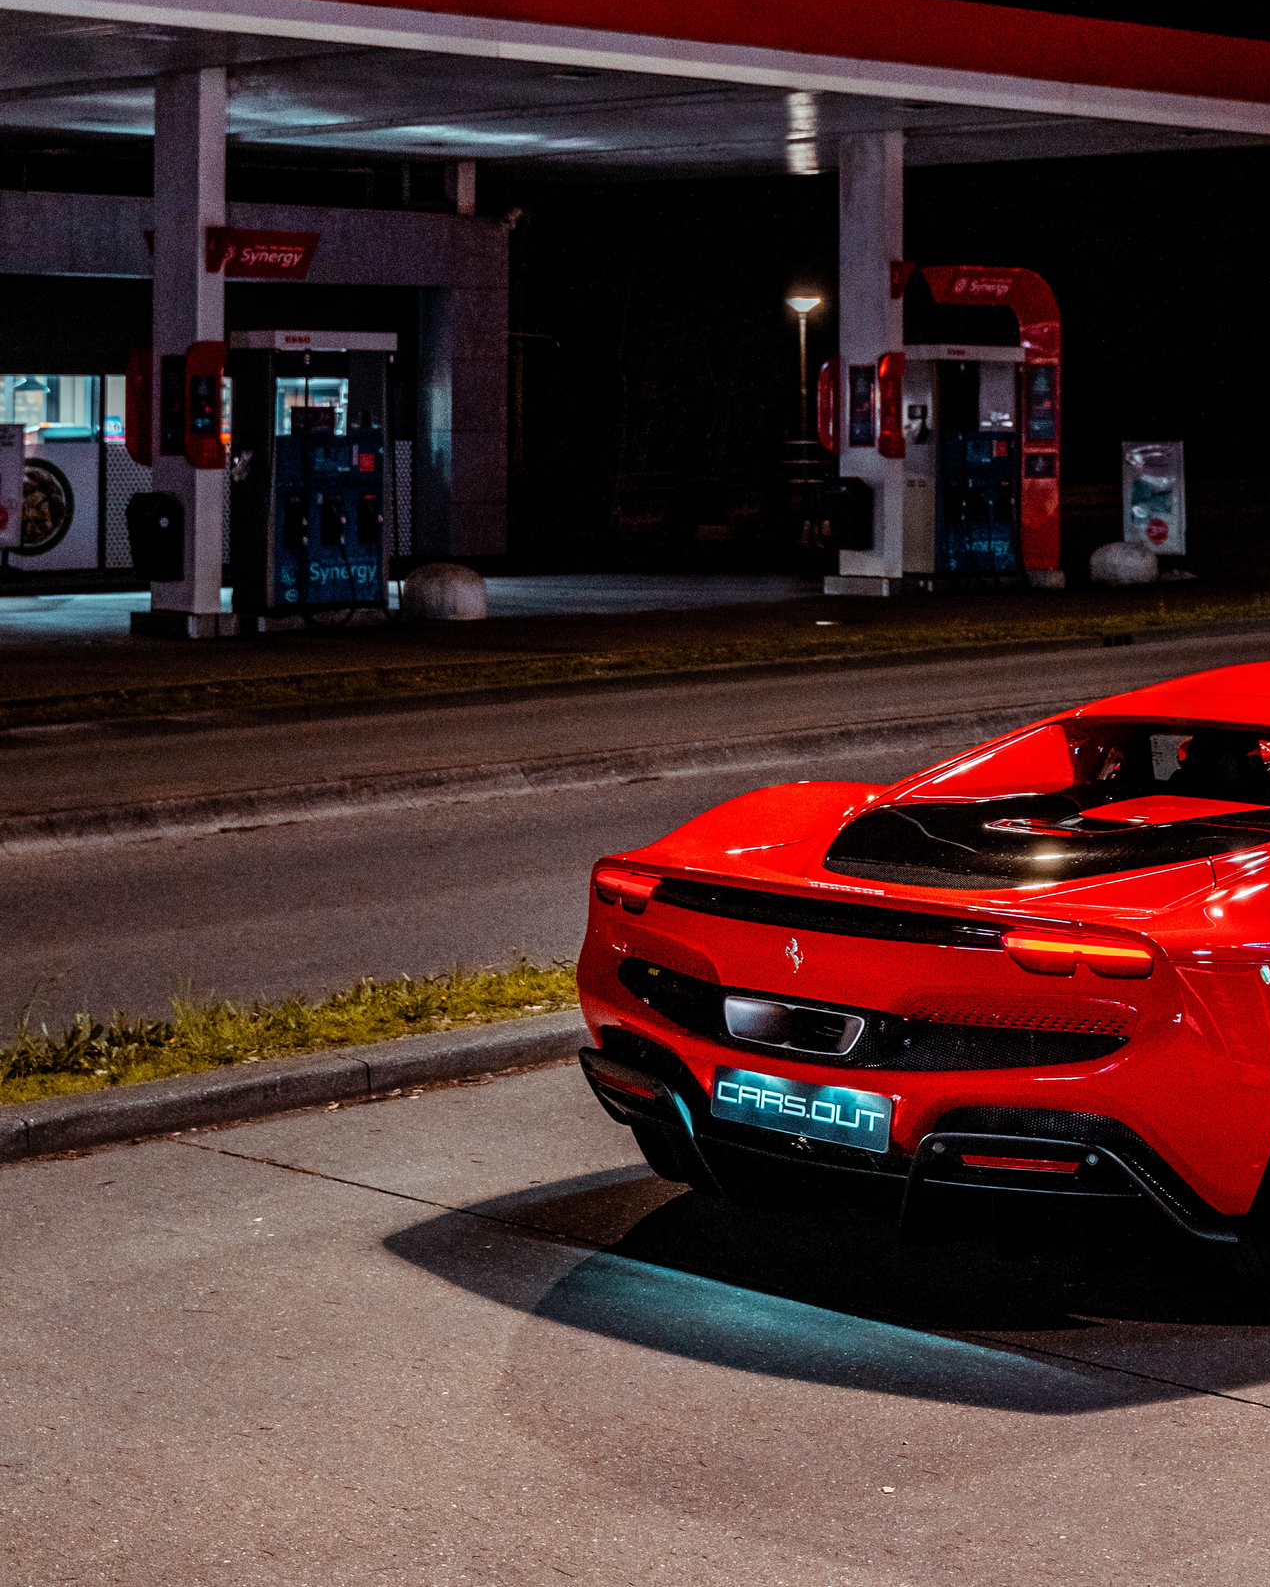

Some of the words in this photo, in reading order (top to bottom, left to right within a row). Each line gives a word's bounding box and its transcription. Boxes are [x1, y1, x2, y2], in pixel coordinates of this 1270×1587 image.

[240, 246, 304, 267] Synergy
[309, 562, 378, 585] Synergy
[716, 1080, 885, 1132] CARS.OUT
